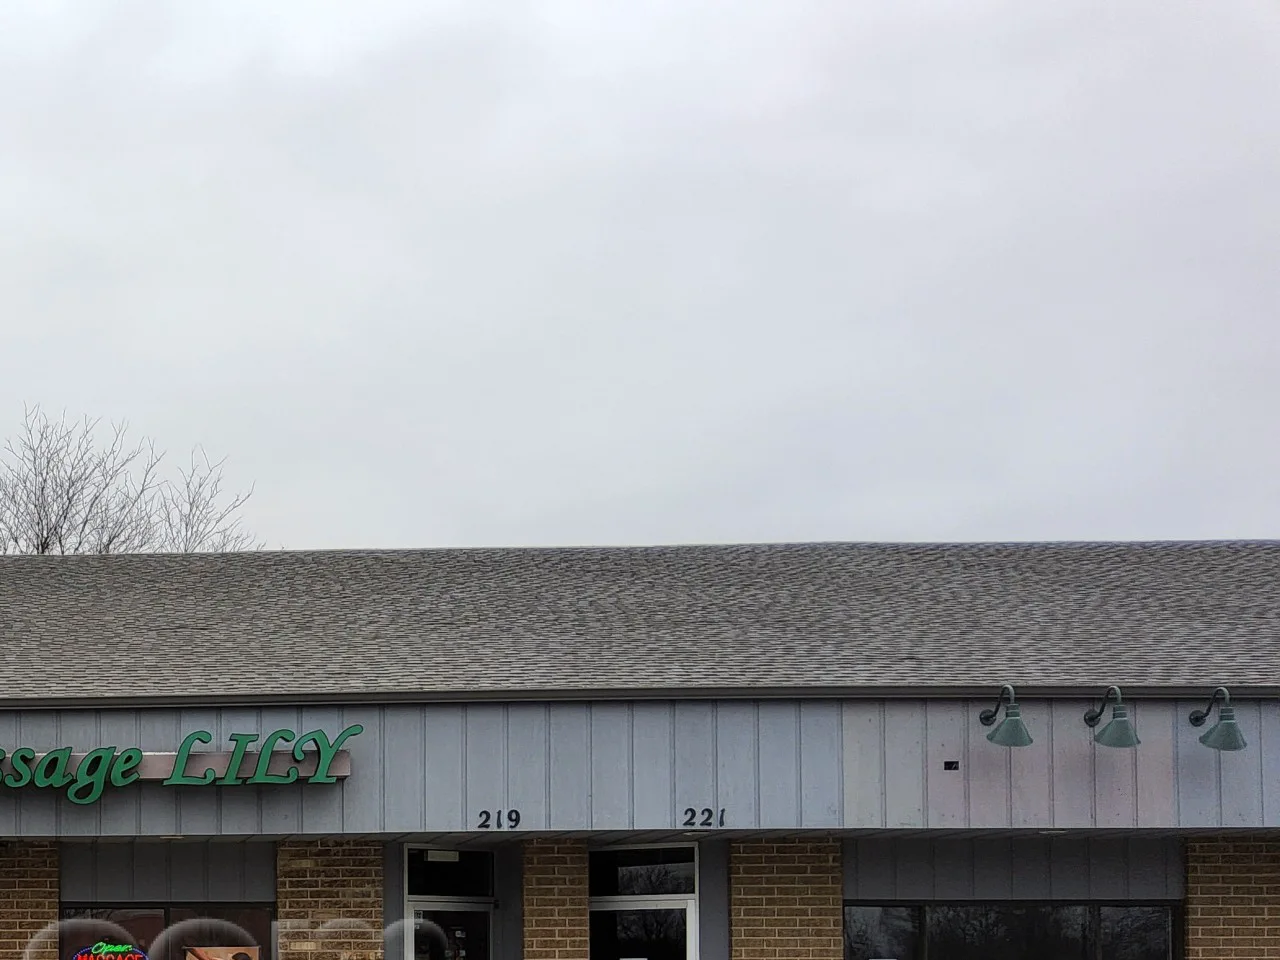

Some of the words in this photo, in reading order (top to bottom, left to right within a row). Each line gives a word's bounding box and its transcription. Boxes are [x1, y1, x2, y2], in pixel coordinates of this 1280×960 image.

[163, 724, 363, 786] LILY
[478, 809, 521, 829] 219
[683, 808, 726, 827] 221
